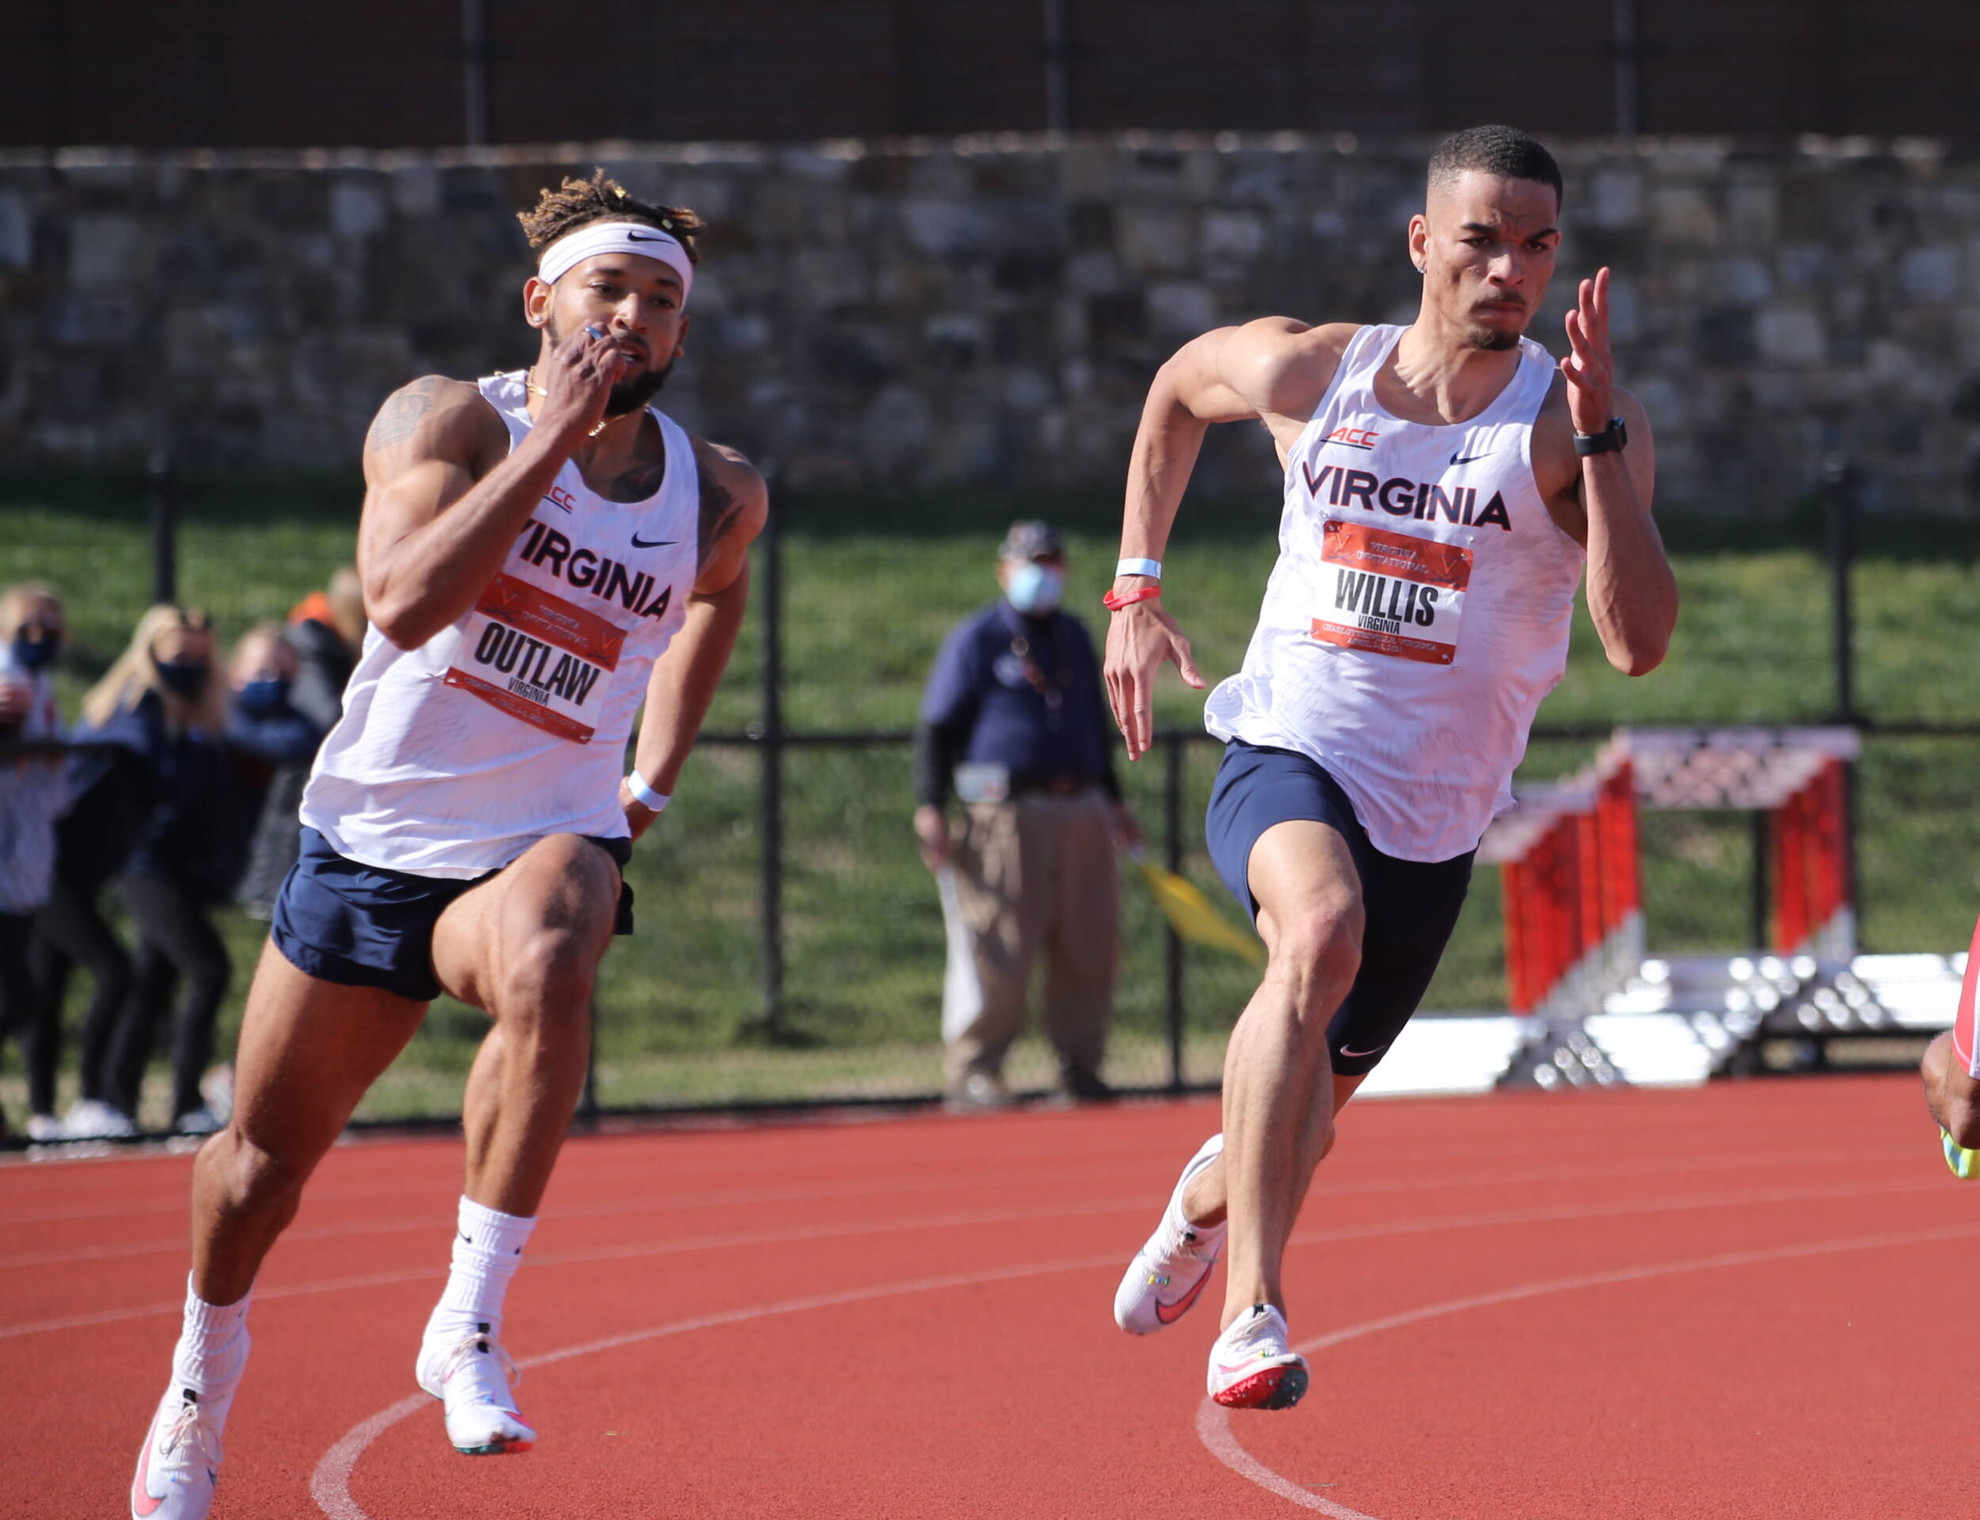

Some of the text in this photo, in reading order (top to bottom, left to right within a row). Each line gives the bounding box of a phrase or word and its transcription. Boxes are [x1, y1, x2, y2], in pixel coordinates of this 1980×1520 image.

[1326, 427, 1380, 447] ACC
[1302, 461, 1512, 532] VIRGINIA
[1335, 568, 1439, 627] WILLIS
[1358, 615, 1401, 635] VIRGINIA
[474, 622, 601, 706] OUTLAW
[508, 677, 551, 706] VIRGINIA
